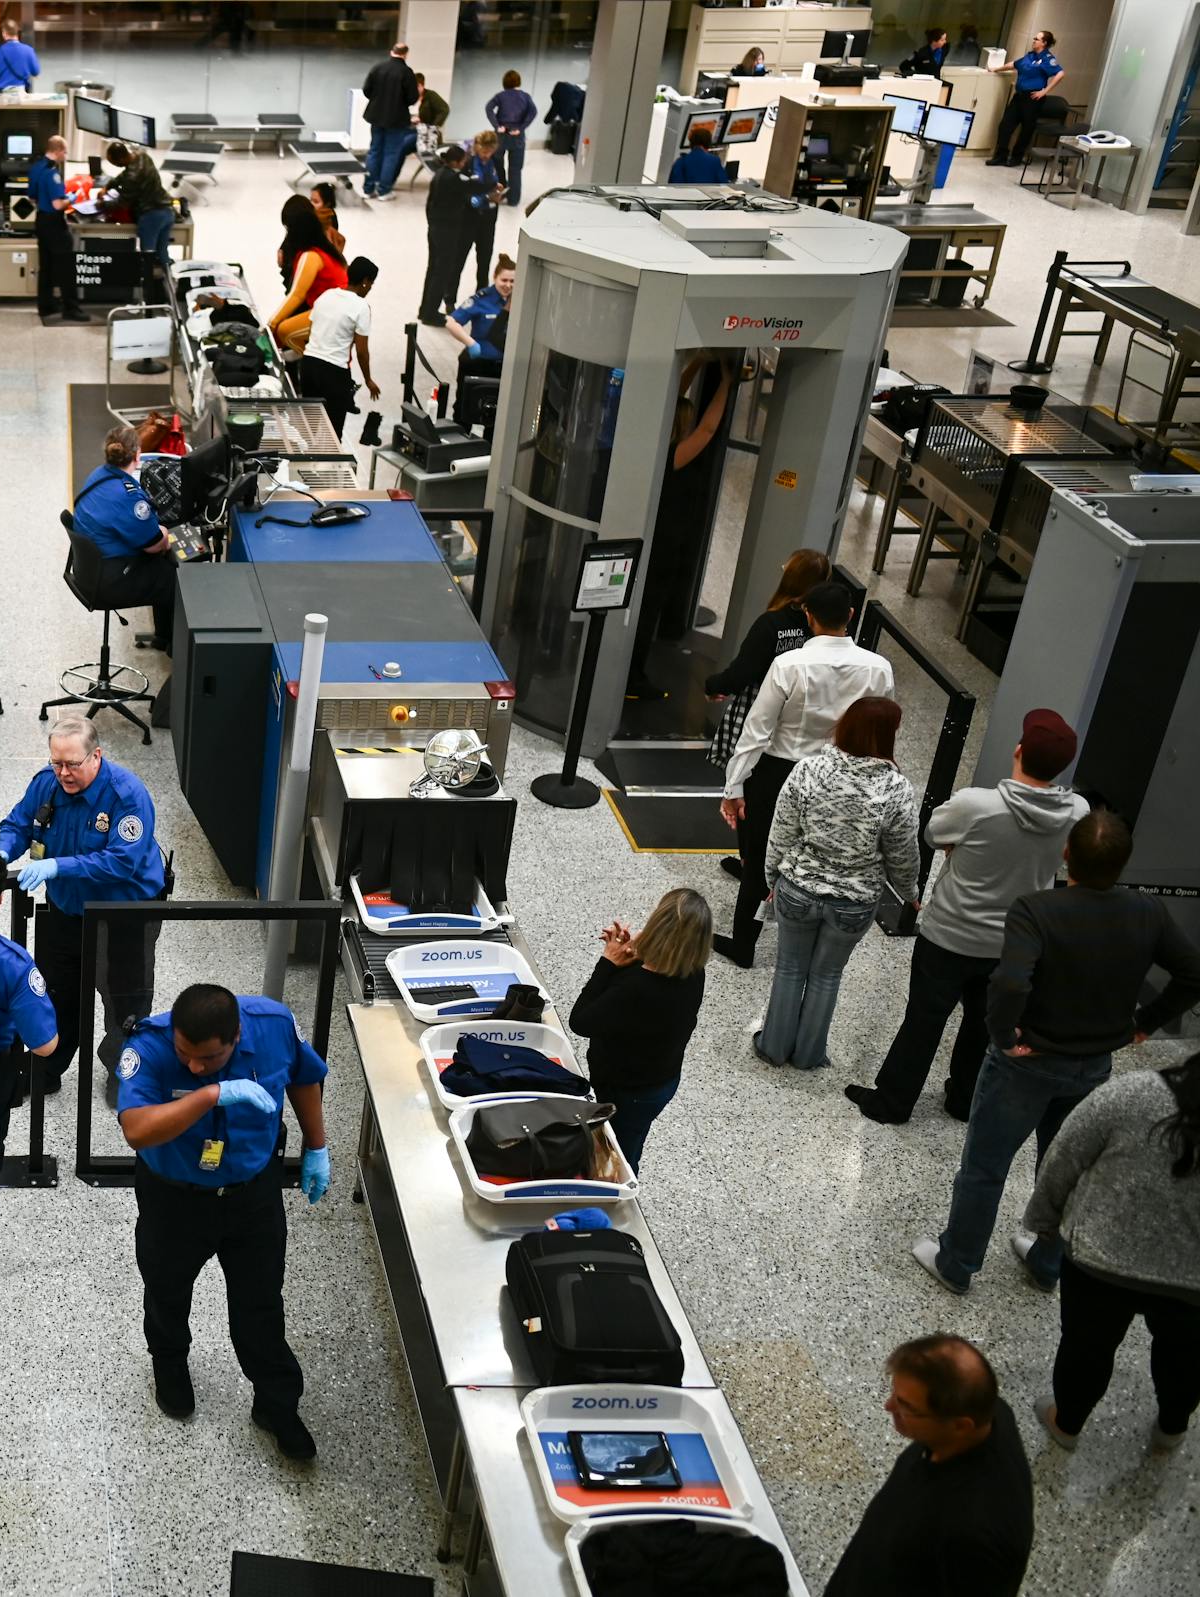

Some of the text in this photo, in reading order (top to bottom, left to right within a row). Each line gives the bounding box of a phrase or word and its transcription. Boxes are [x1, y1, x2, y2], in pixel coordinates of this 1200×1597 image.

[75, 253, 112, 264] Please
[75, 264, 100, 274] Wait
[75, 274, 102, 285] Here
[740, 316, 804, 328] ProVision
[771, 329, 800, 341] ATD
[1138, 886, 1160, 895] Push
[1162, 887, 1172, 895] to
[1175, 887, 1198, 897] Open
[421, 949, 483, 962] zoom.us
[572, 1397, 658, 1409] zoom.us
[660, 1496, 720, 1505] zoom.us
